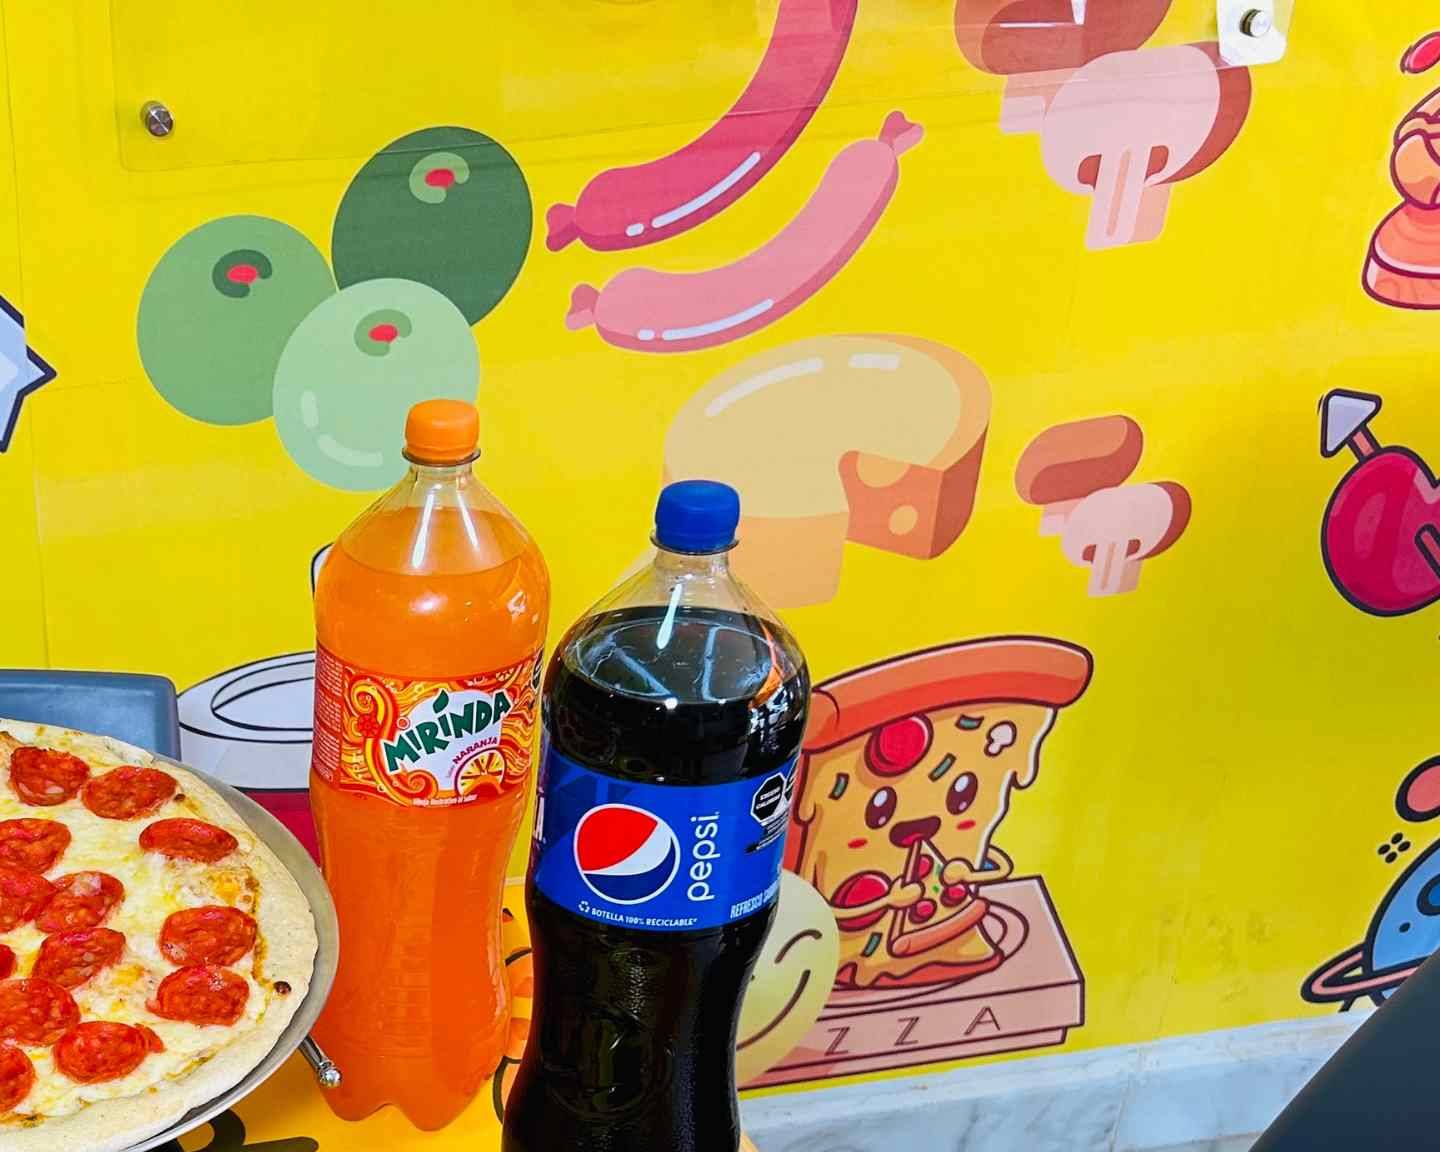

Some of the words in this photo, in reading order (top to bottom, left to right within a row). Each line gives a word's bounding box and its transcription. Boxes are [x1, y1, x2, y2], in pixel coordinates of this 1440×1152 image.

[452, 736, 498, 764] NARANJA
[687, 816, 721, 902] pepsi
[591, 907, 625, 924] BOTELLA
[625, 915, 645, 925] 100%
[729, 891, 763, 920] REFRESCO
[823, 1005, 1002, 1057] ZZA
